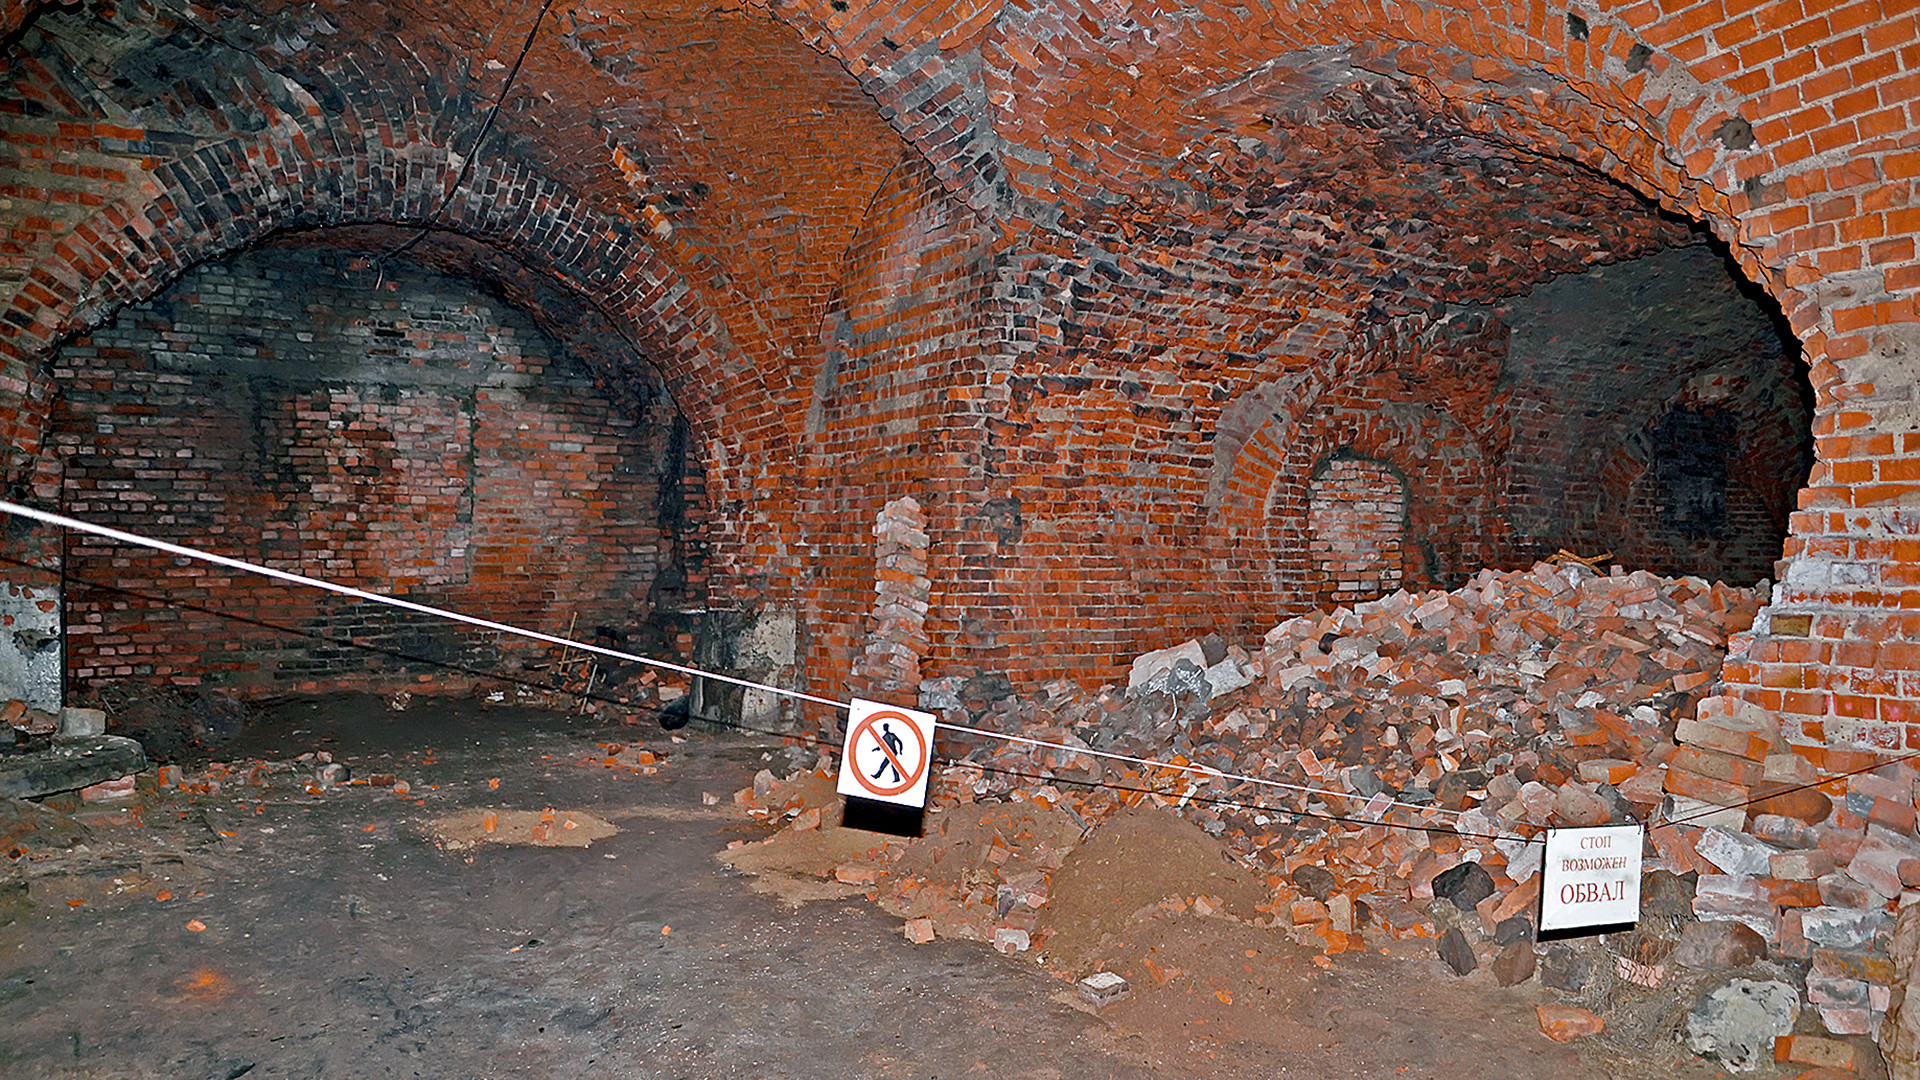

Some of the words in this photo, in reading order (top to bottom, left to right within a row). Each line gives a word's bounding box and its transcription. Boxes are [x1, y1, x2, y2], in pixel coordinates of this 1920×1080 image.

[1580, 835, 1612, 850] СТОП
[1562, 856, 1627, 872] ВОЗМОЖЕН
[1560, 880, 1625, 905] ОБВАЛ
